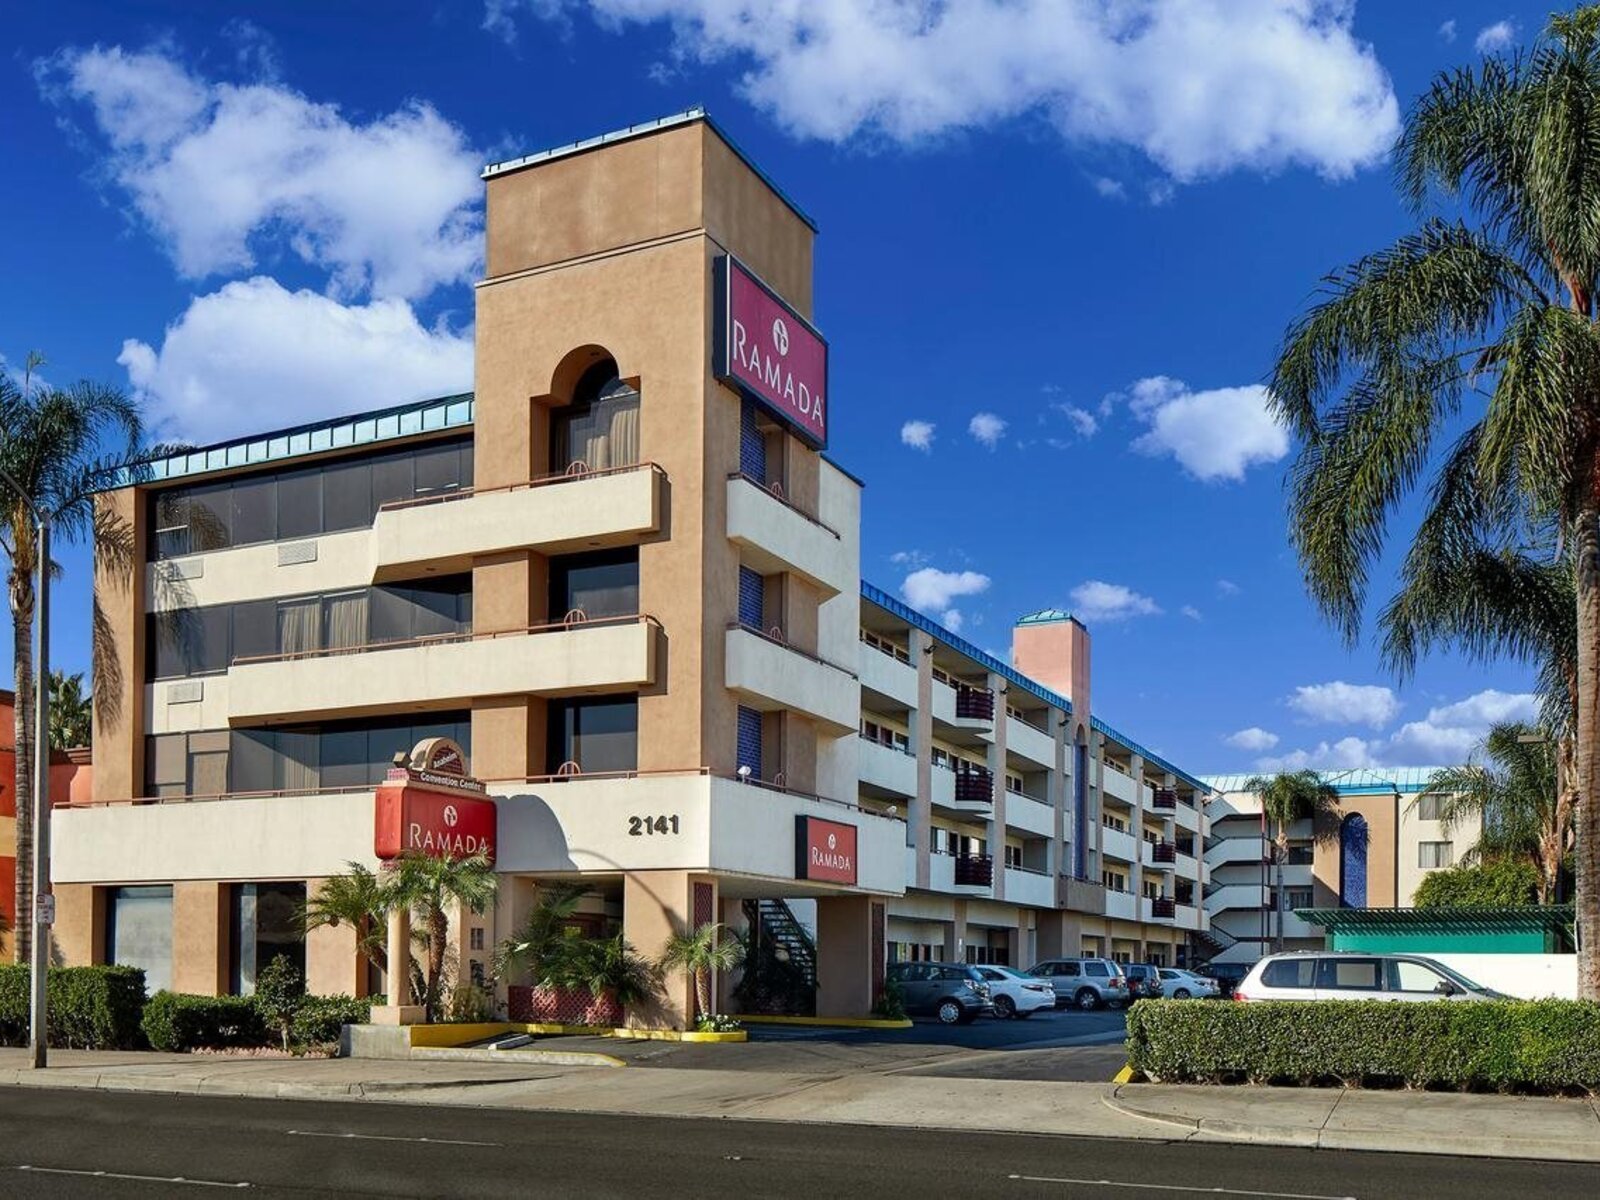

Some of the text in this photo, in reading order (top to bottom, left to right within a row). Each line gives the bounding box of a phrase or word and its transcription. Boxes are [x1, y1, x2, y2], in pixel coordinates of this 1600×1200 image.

[733, 319, 824, 427] RAMADA
[433, 751, 458, 769] Anaheim
[420, 771, 481, 791] Convention Center
[628, 814, 679, 836] 2141
[409, 823, 488, 854] RAMADA
[812, 846, 851, 870] RAMADA
